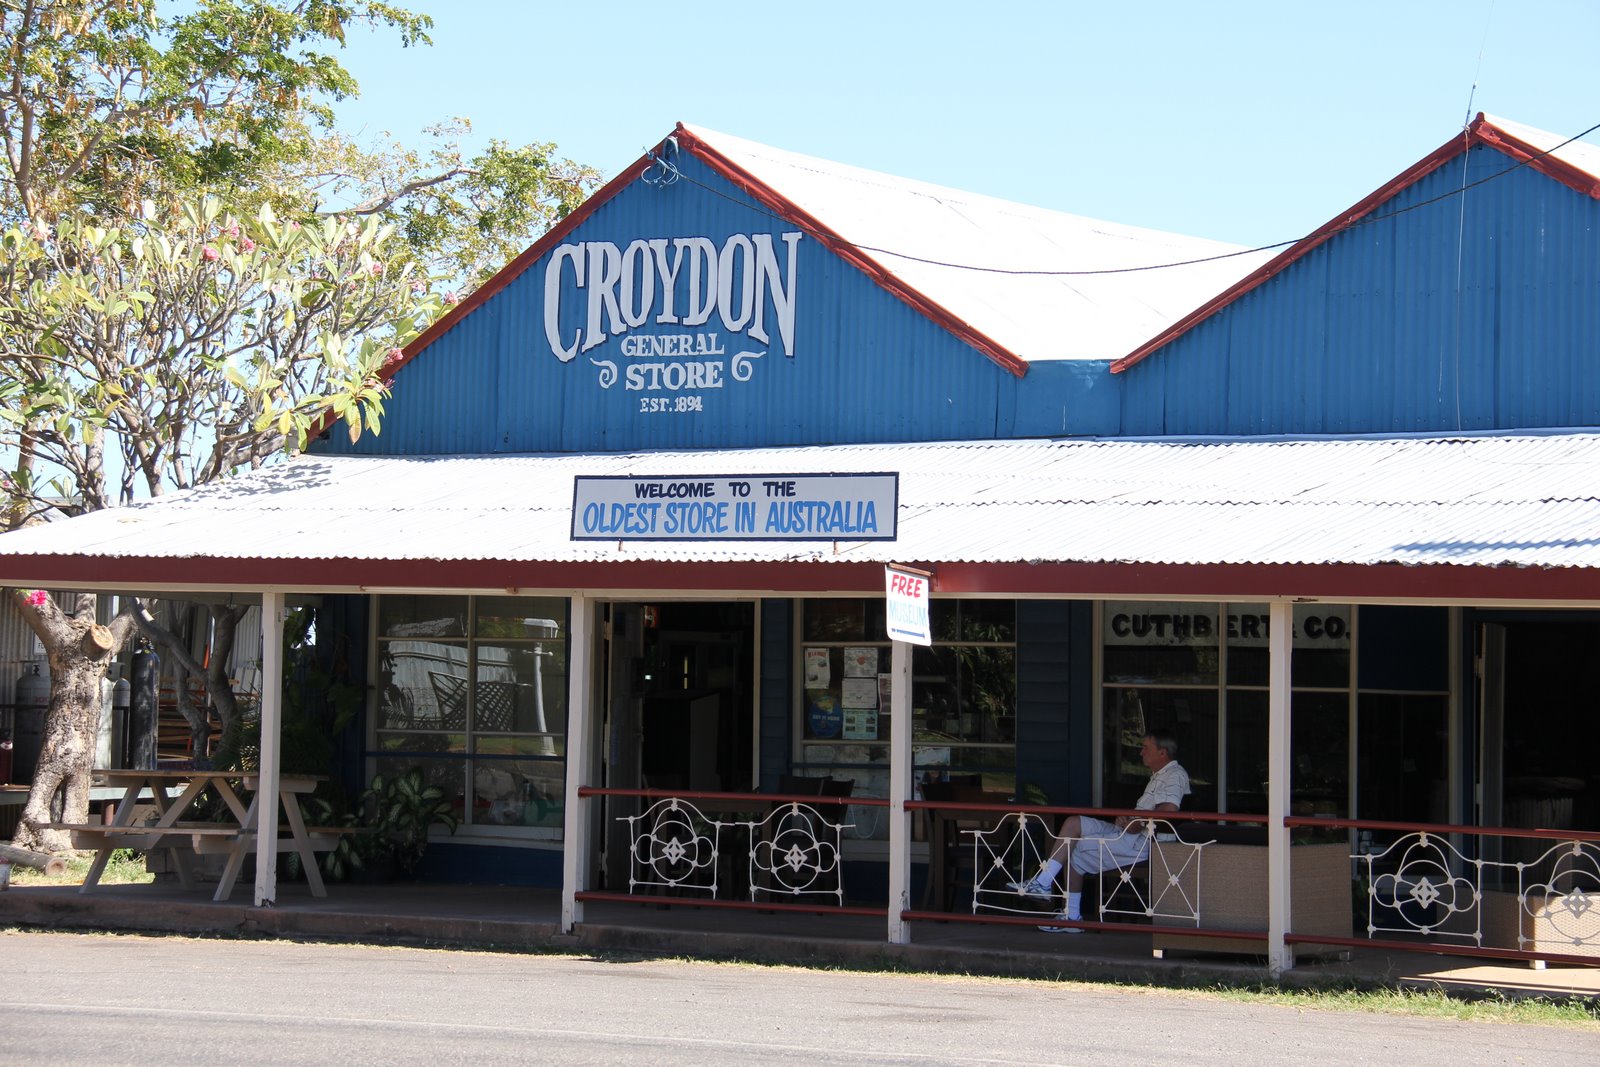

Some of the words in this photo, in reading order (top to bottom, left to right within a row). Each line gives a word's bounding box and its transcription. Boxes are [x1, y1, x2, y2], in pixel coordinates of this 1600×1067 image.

[544, 232, 802, 363] CROYDON
[620, 333, 725, 357] GENERAL
[625, 361, 723, 391] STORE
[634, 482, 715, 498] WELCOME
[728, 481, 751, 497] TO
[762, 481, 796, 497] THE
[582, 502, 662, 534] OLDEST
[663, 501, 729, 534] STORE
[734, 501, 756, 533] IN
[764, 500, 878, 533] AUSTRALIA
[891, 574, 922, 598] FREE
[889, 599, 928, 627] MUSEUM
[1303, 616, 1350, 640] CO.
